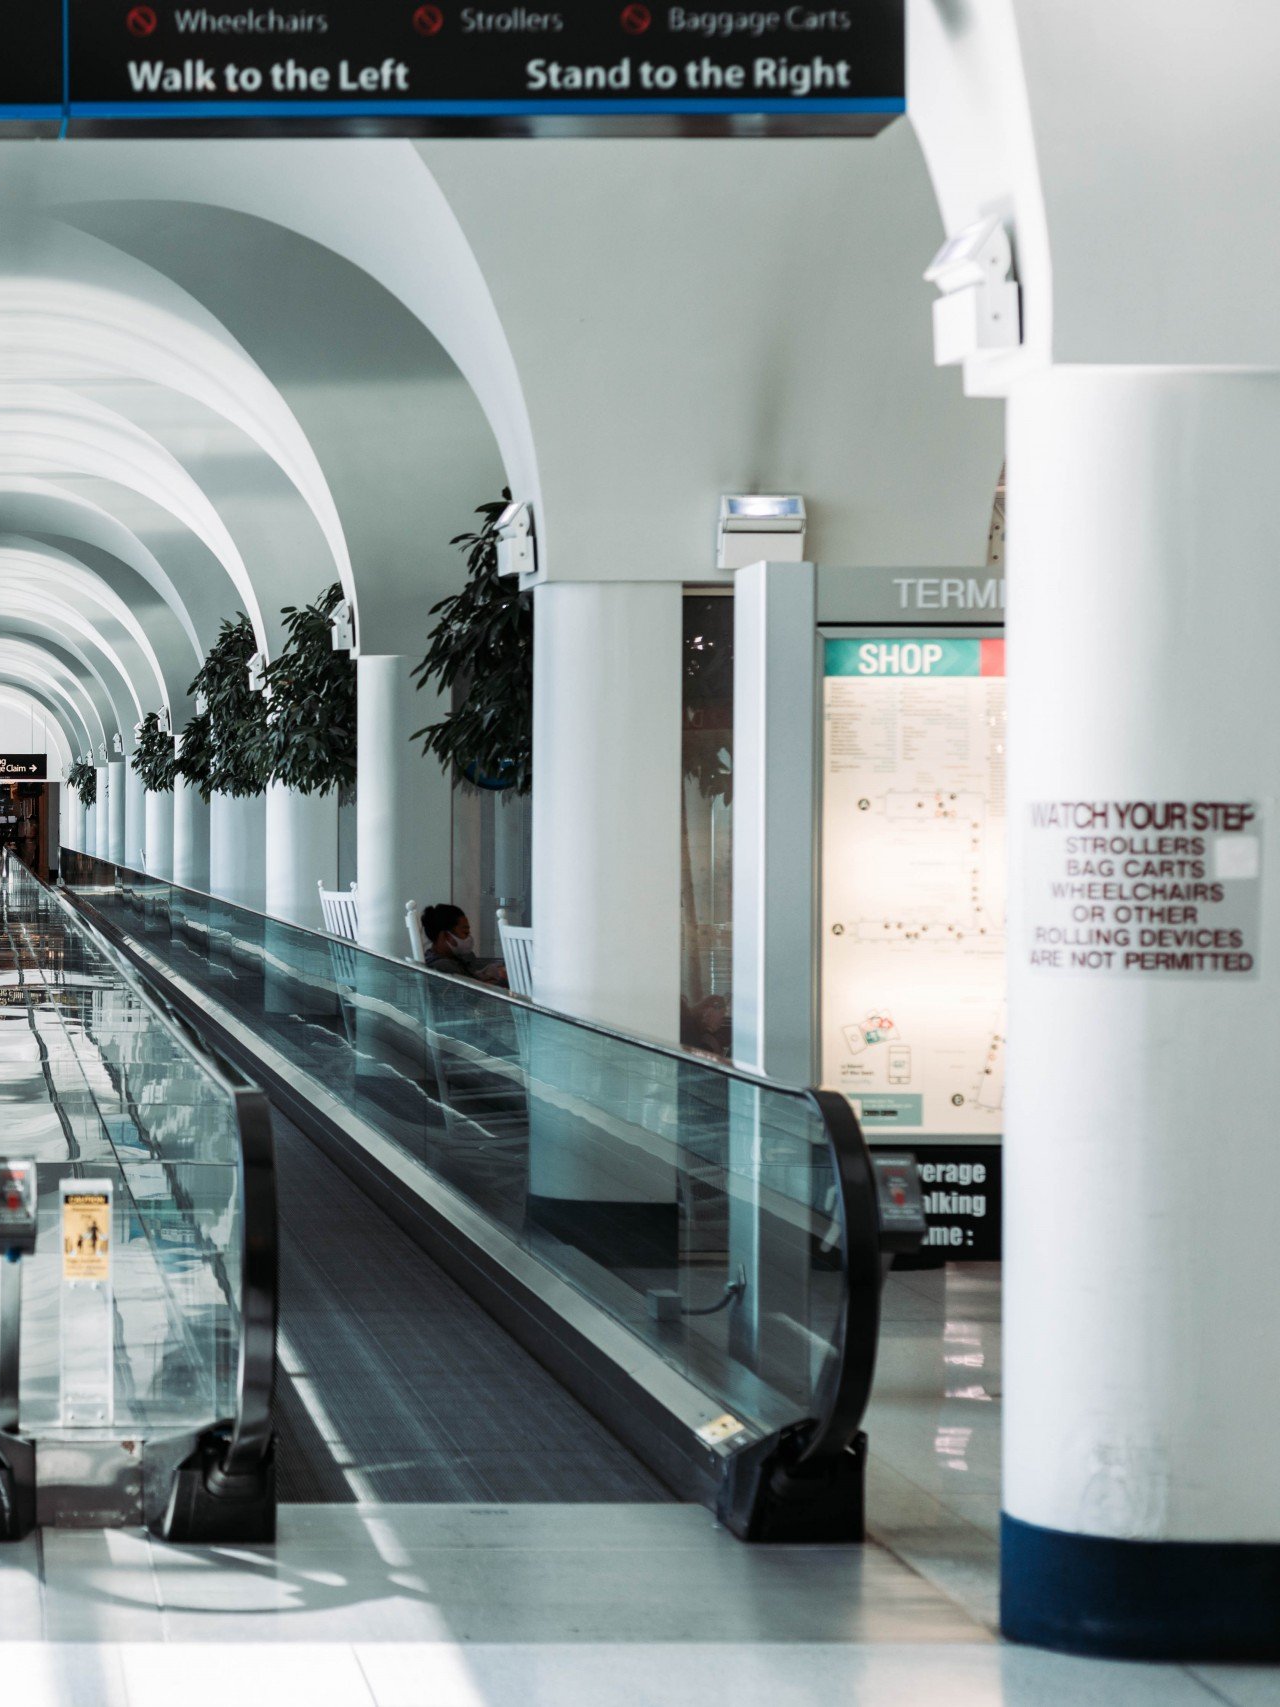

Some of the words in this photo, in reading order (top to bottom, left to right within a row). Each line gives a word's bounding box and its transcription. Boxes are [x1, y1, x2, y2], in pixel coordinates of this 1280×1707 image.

[174, 8, 328, 33] Wheelchairs
[461, 8, 563, 32] Strollers
[668, 7, 780, 36] Baggage
[785, 6, 851, 31] Carts
[128, 58, 217, 92] Walk
[224, 63, 263, 92] to
[270, 58, 330, 91] the
[339, 58, 409, 91] Left
[525, 58, 631, 91] Stand
[639, 62, 677, 89] to
[685, 58, 745, 88] the
[753, 57, 851, 96] Right
[893, 578, 1004, 608] TERMI
[858, 644, 943, 675] SHOP
[6, 764, 27, 772] Claim
[1031, 802, 1108, 829] WATCH
[1115, 802, 1188, 830] YOUR
[1066, 836, 1206, 855] STROLLERS
[1066, 860, 1115, 878] BAG
[1123, 860, 1206, 878] CARTS
[1051, 882, 1225, 901] WHEELCHAIRS
[1072, 905, 1105, 923] OR
[1114, 906, 1198, 925] OTHER
[1035, 927, 1131, 946] ROLLING
[1139, 929, 1243, 948] DEVICES
[1030, 950, 1067, 967] ARE
[1072, 952, 1116, 969] NOT
[1124, 952, 1254, 972] PERMITTED
